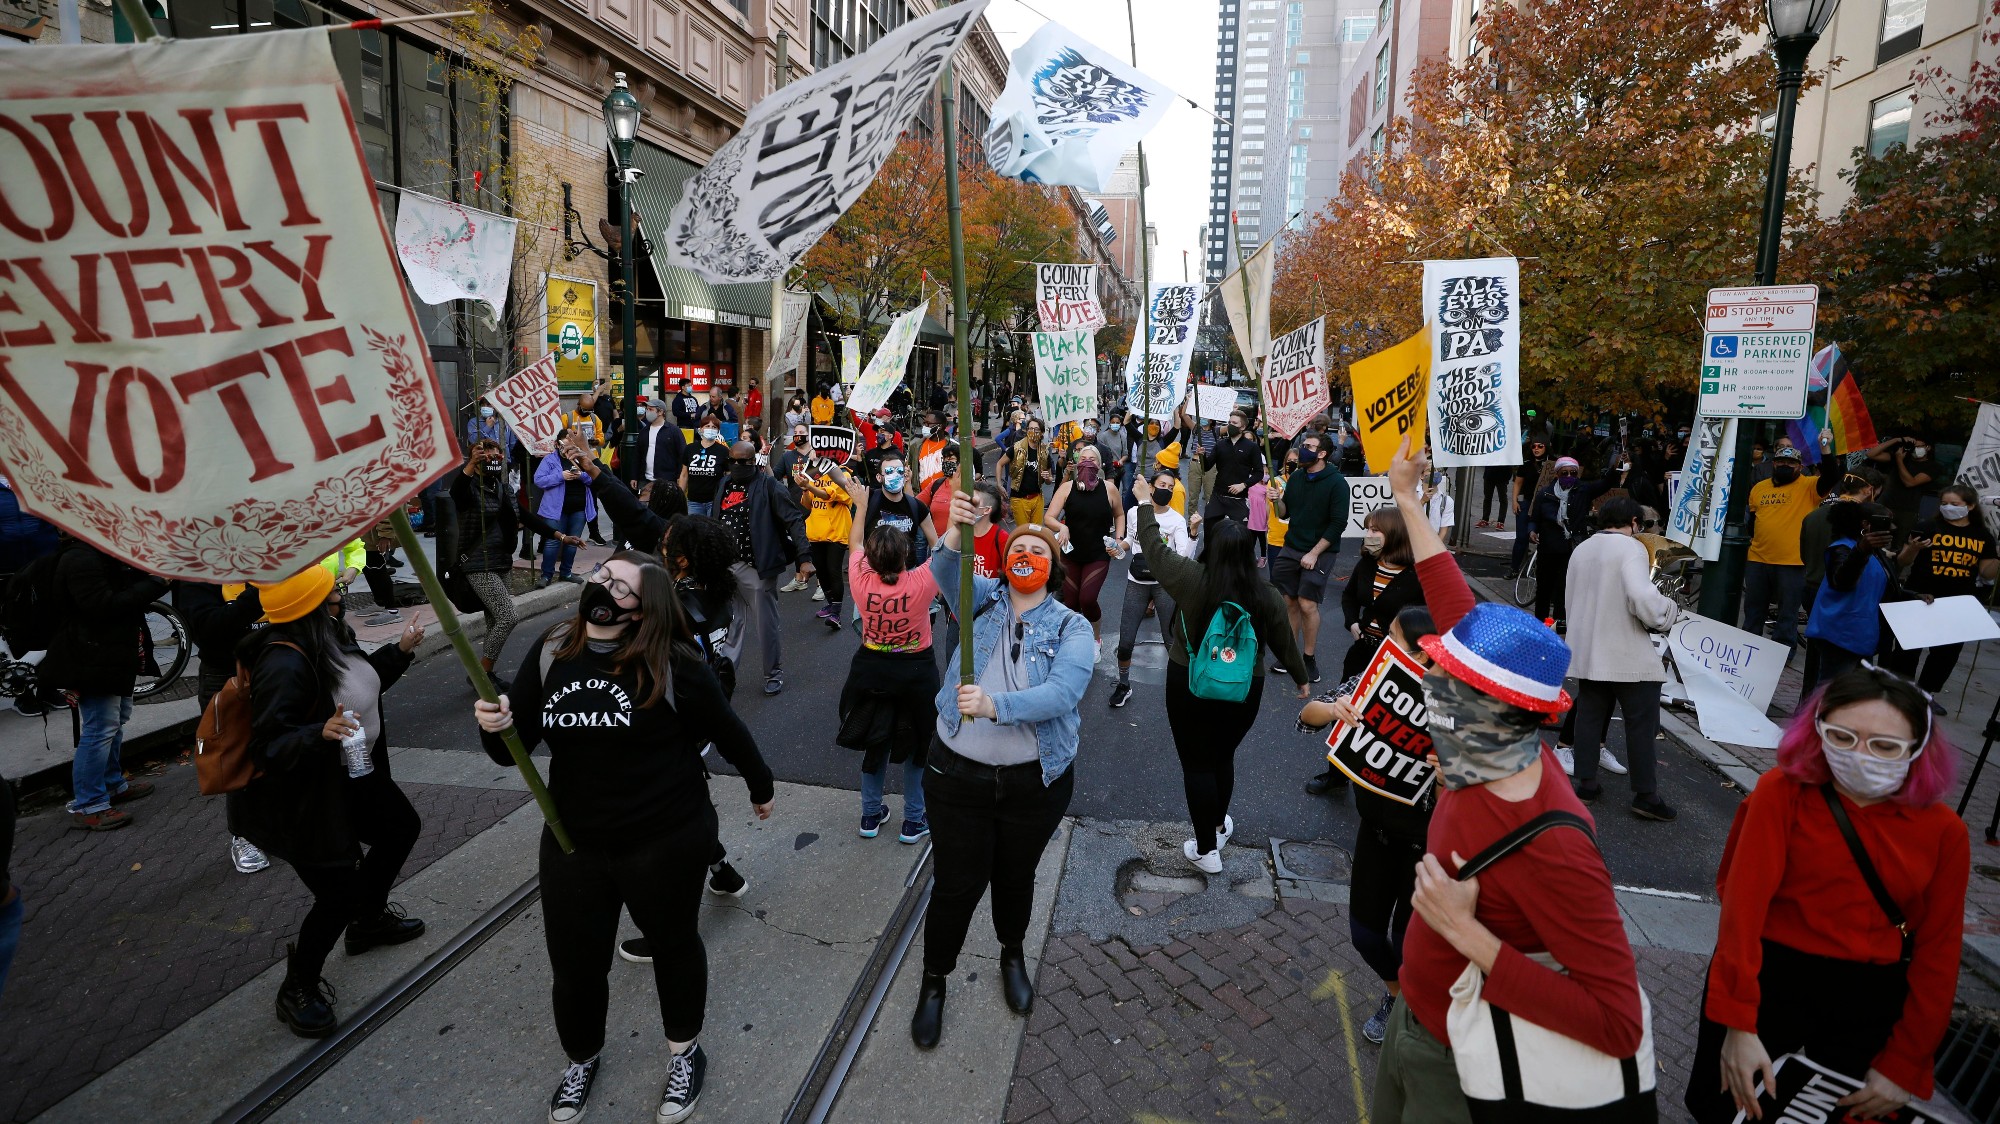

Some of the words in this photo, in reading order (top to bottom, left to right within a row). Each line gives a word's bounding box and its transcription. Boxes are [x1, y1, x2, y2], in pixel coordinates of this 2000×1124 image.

[0, 103, 321, 242] OUNT
[1041, 264, 1092, 286] COUNT
[1043, 285, 1090, 301] EVERY
[1162, 287, 1191, 300] ALL
[1450, 278, 1501, 294] ALL
[1157, 298, 1190, 310] EYES
[1446, 291, 1502, 310] EYES
[683, 305, 715, 321] READING
[719, 310, 751, 326] TERMINAL
[1041, 300, 1097, 324] VOTE
[1709, 307, 1726, 318] NO
[1731, 306, 1795, 316] STOPPING
[1163, 318, 1177, 327] ON
[1461, 317, 1484, 330] ON
[1151, 327, 1179, 344] PA
[1271, 319, 1320, 361] COUNT
[1447, 330, 1491, 359] PA
[1741, 335, 1806, 346] RESERVED
[1269, 345, 1317, 379] EVERY
[1744, 348, 1802, 359] PARKING
[667, 367, 683, 375] SPARE
[693, 367, 706, 376] BABY
[1437, 364, 1479, 388] THE
[1708, 368, 1715, 376] 2
[1724, 368, 1738, 376] HR
[494, 356, 558, 408] COUNT
[692, 377, 708, 386] BACKS
[1266, 366, 1319, 409] VOTE
[1439, 373, 1502, 404] WHOLE
[1707, 384, 1714, 392] 3
[1722, 384, 1737, 392] HR
[510, 381, 559, 422] EVER
[1365, 364, 1421, 424] VOTERS
[0, 327, 386, 493] VOTE
[1438, 391, 1496, 420] WORLD
[515, 401, 562, 442] VOT
[1448, 417, 1457, 432] IS
[812, 435, 852, 451] COUNT
[1440, 422, 1506, 456] WATCHING
[690, 454, 717, 467] 215
[1352, 484, 1394, 500] COU
[1932, 533, 1985, 554] COUNT
[1931, 549, 1978, 567] EVERY
[1933, 565, 1971, 578] VOTE
[865, 592, 911, 614] Eat
[867, 614, 910, 634] the
[1680, 620, 1760, 668] COUNT
[1719, 663, 1743, 679] THE
[544, 681, 583, 710] YEAR
[586, 678, 610, 690] OF
[608, 683, 632, 712] THE
[1378, 680, 1430, 733] COU
[542, 711, 633, 729] WOMAN
[1364, 702, 1438, 755] EVER
[1349, 721, 1434, 786] VOTE
[1360, 767, 1386, 788] CWA
